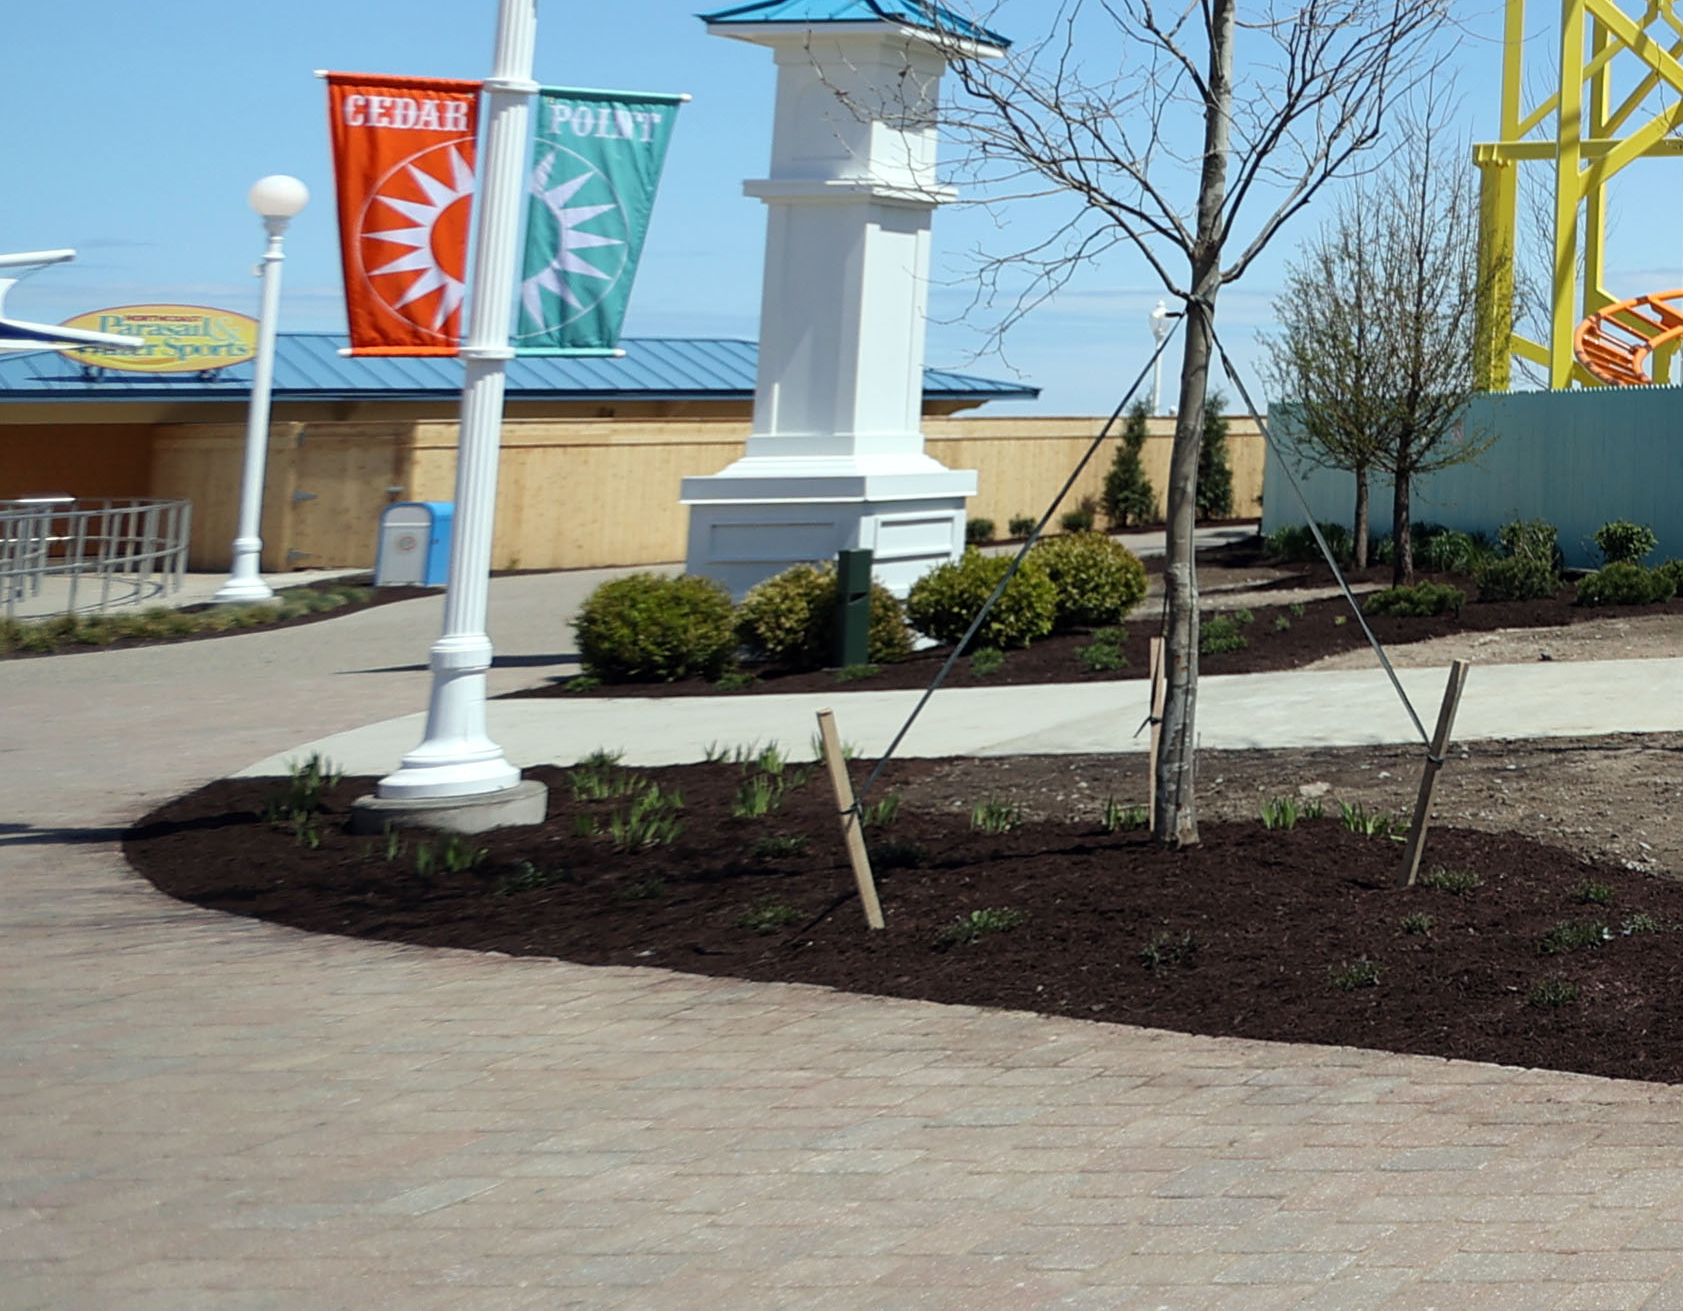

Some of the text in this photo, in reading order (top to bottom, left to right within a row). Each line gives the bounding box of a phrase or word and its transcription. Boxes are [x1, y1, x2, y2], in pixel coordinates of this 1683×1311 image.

[344, 94, 469, 132] CEDAR
[546, 104, 662, 142] POINT
[98, 315, 242, 342] Parasail &
[163, 337, 250, 361] Sports
